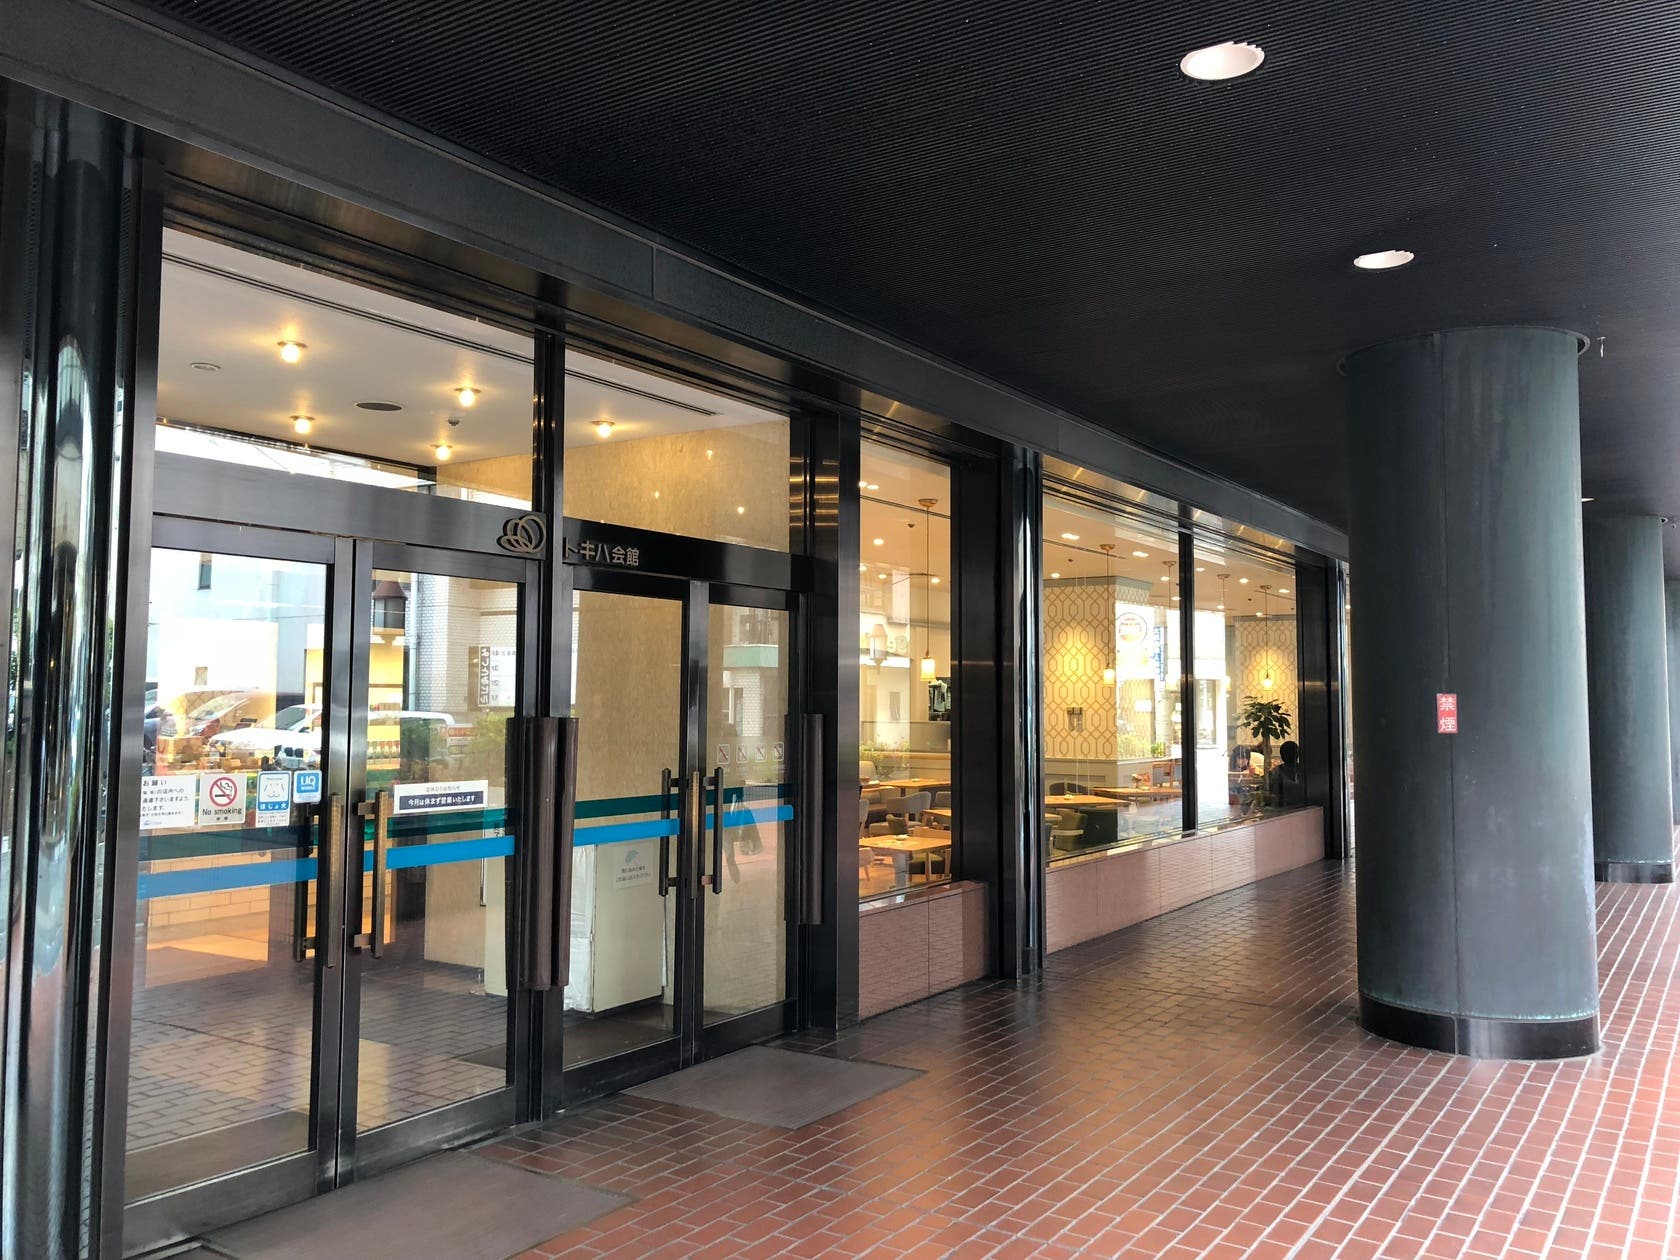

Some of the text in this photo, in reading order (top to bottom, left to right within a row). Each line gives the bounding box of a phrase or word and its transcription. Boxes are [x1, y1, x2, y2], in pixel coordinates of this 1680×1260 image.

[565, 538, 640, 566] トキハ会館
[1439, 696, 1457, 731] 禁煙
[300, 775, 317, 786] UQ
[408, 795, 476, 807] 今月は休まず営業いたします
[202, 807, 242, 816] No smoking
